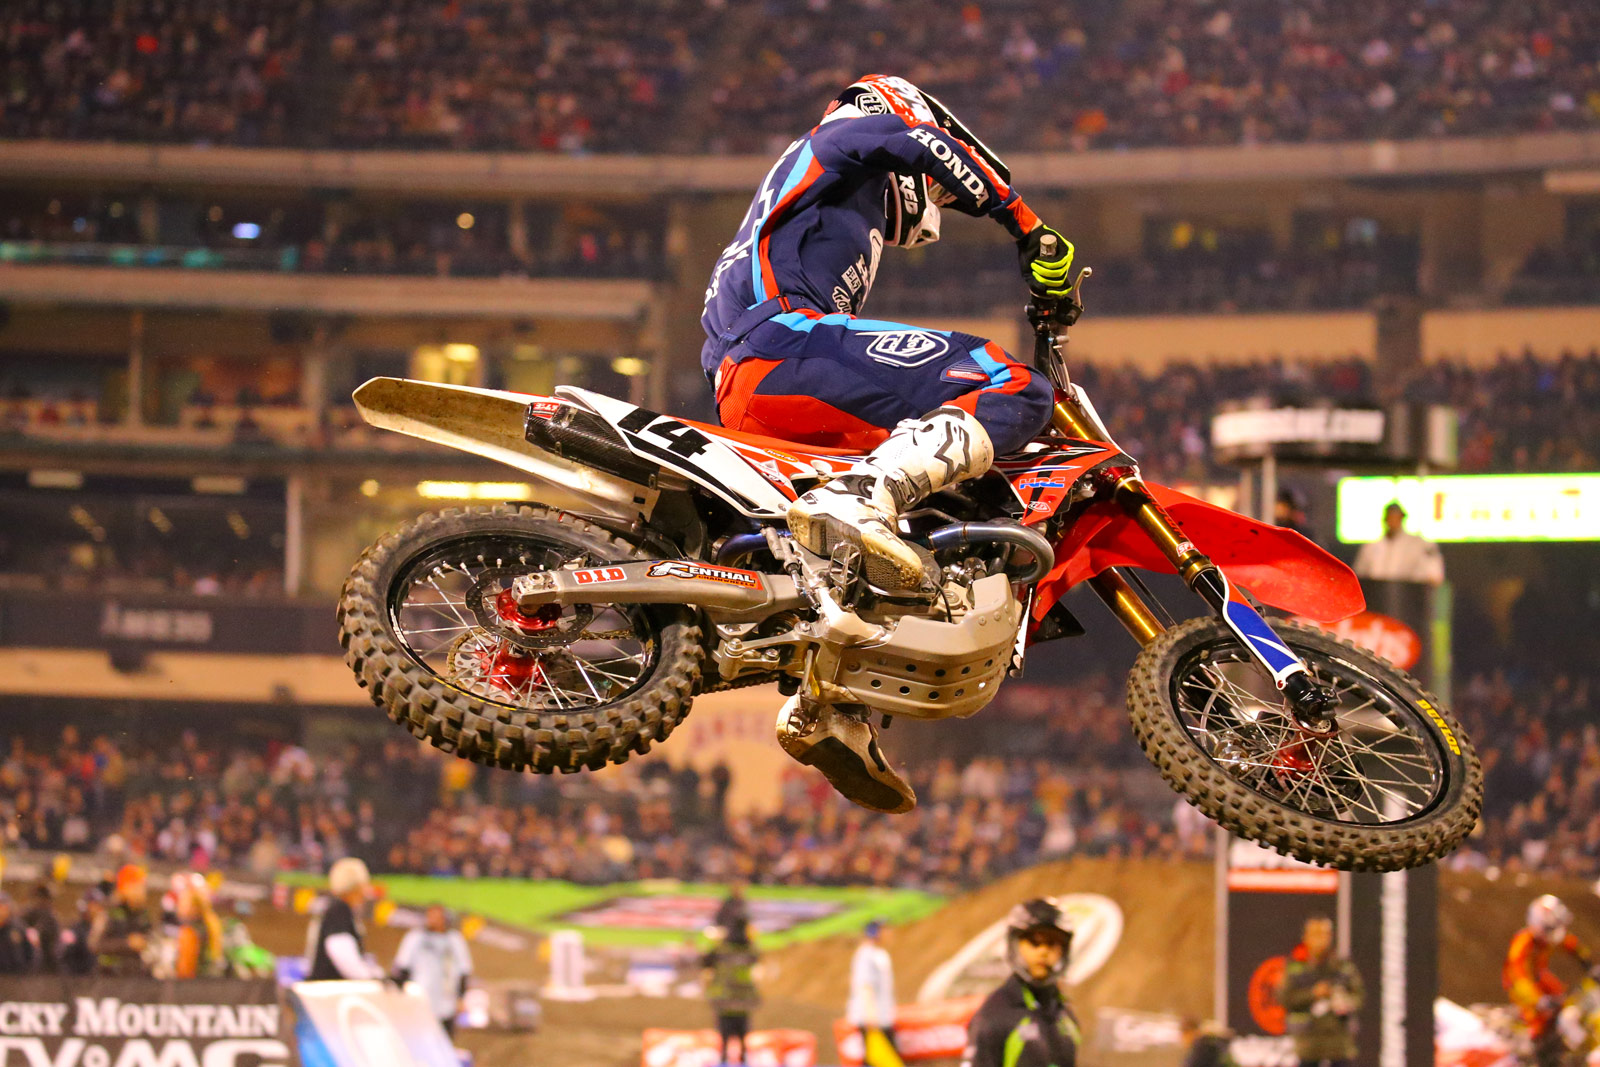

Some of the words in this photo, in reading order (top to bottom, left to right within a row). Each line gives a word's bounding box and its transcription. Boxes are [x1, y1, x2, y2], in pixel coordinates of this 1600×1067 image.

[907, 128, 990, 208] HONDA
[617, 406, 714, 459] 14
[1019, 476, 1066, 490] HRC
[1415, 699, 1461, 756] DUNLOP
